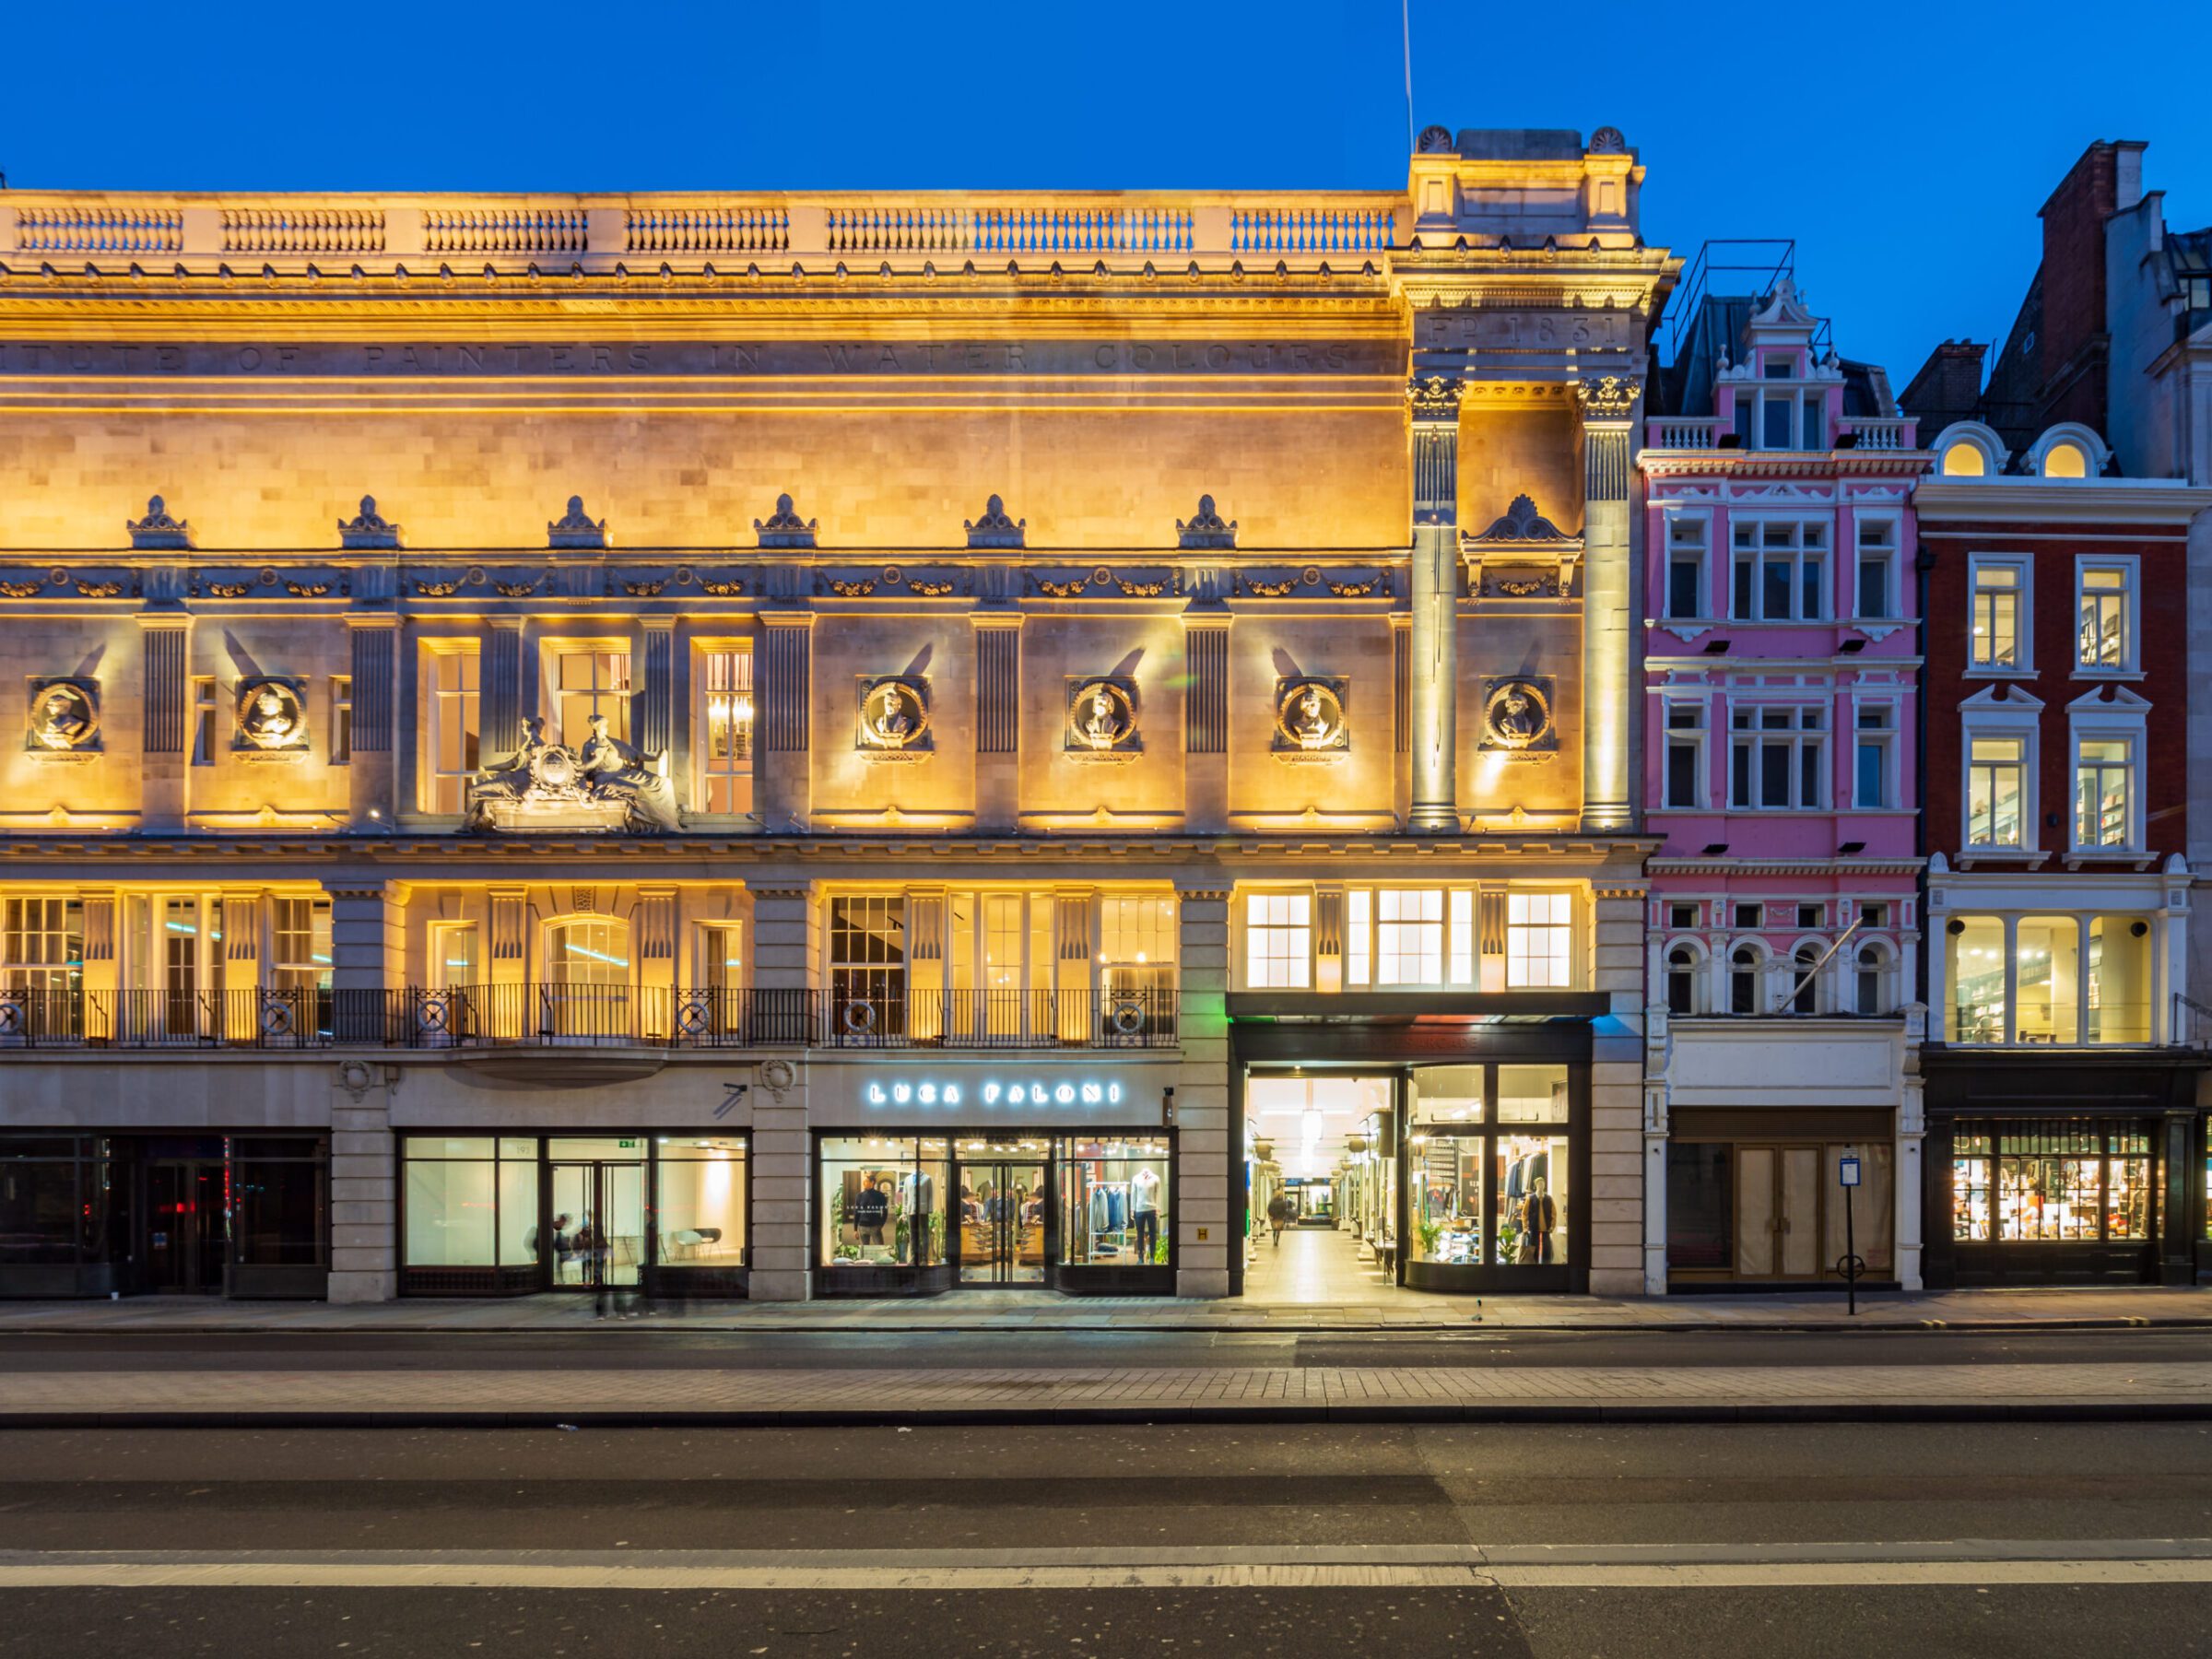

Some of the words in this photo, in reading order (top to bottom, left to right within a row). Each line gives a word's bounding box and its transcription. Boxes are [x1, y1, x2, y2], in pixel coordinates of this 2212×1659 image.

[1510, 317, 1616, 343] 1831
[238, 346, 302, 371] OF
[363, 346, 653, 371] PAINTERS
[710, 346, 763, 371] IN
[823, 345, 1029, 370] WATER
[1093, 345, 1350, 370] COLOURS
[869, 1084, 959, 1103] LUCA
